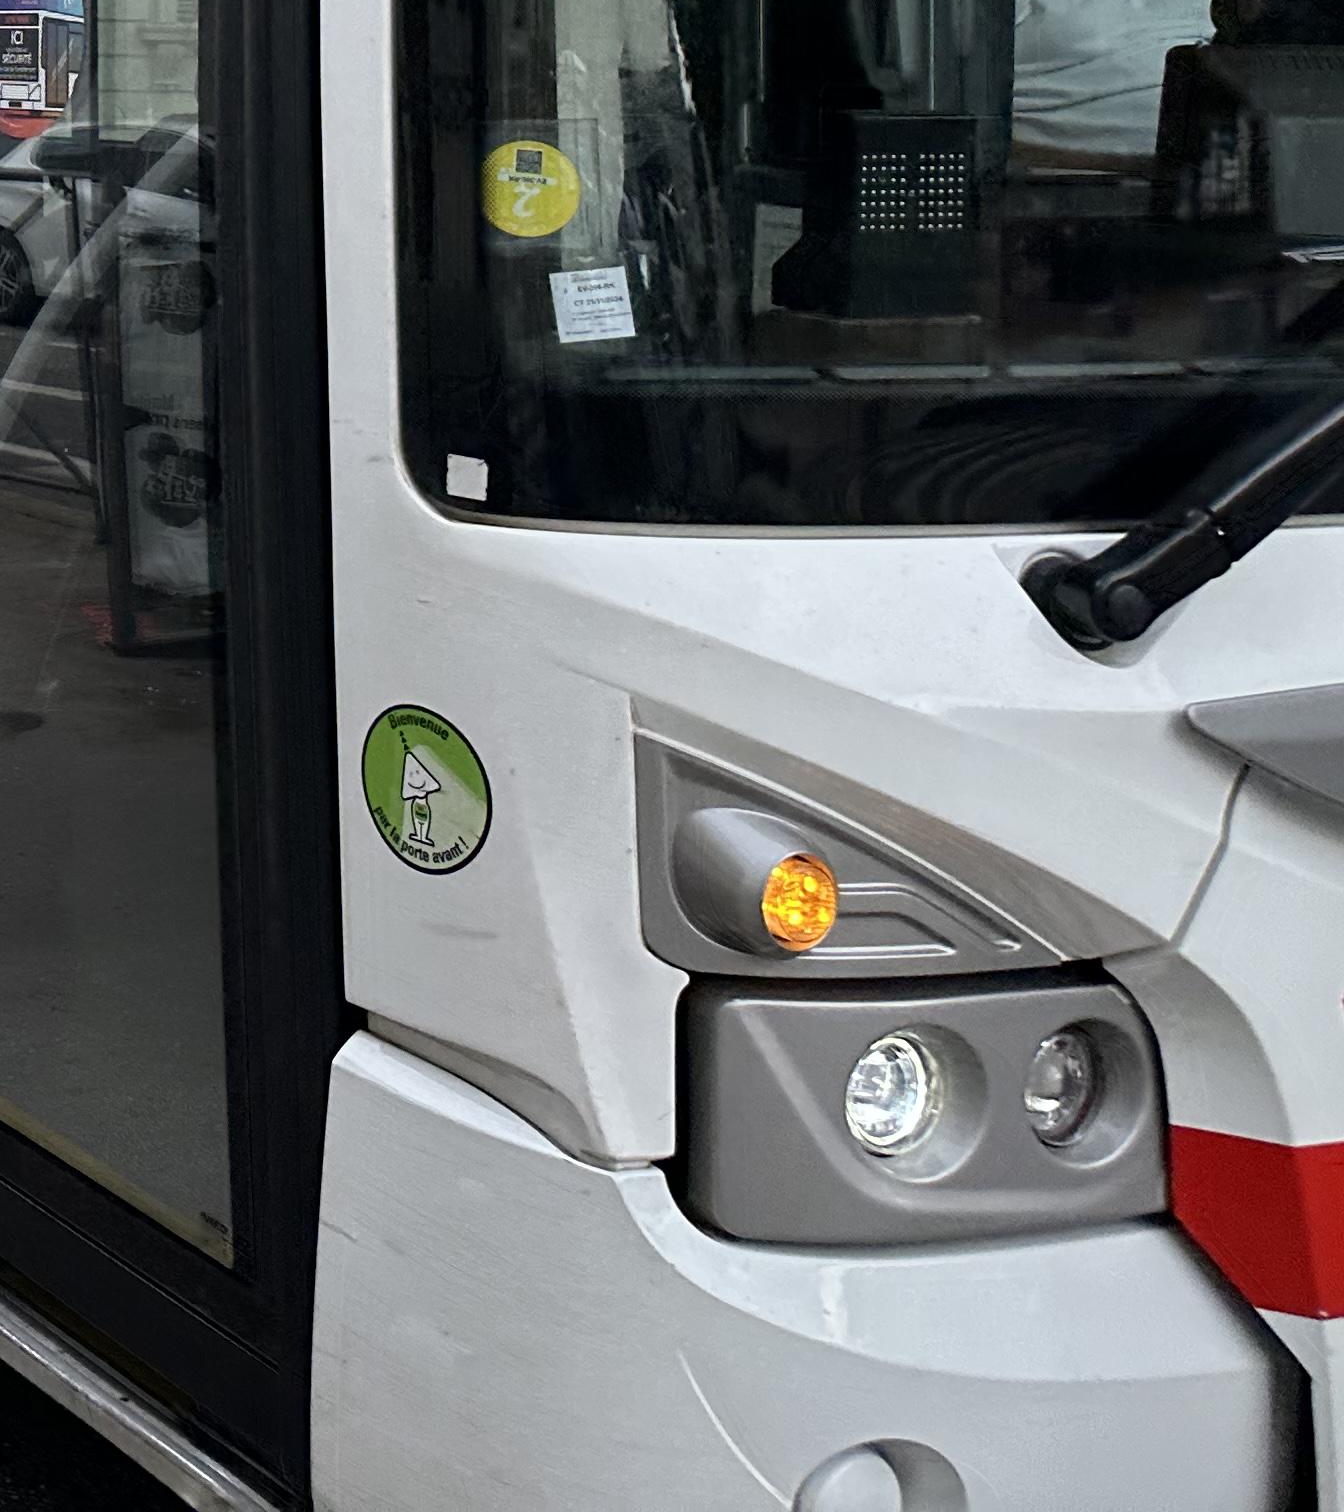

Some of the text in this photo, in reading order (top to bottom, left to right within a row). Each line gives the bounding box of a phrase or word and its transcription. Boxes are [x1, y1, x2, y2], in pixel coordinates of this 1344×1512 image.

[387, 713, 449, 741] Bienvenue
[374, 806, 392, 830] par
[400, 840, 430, 863] porte
[431, 843, 464, 864] avant
